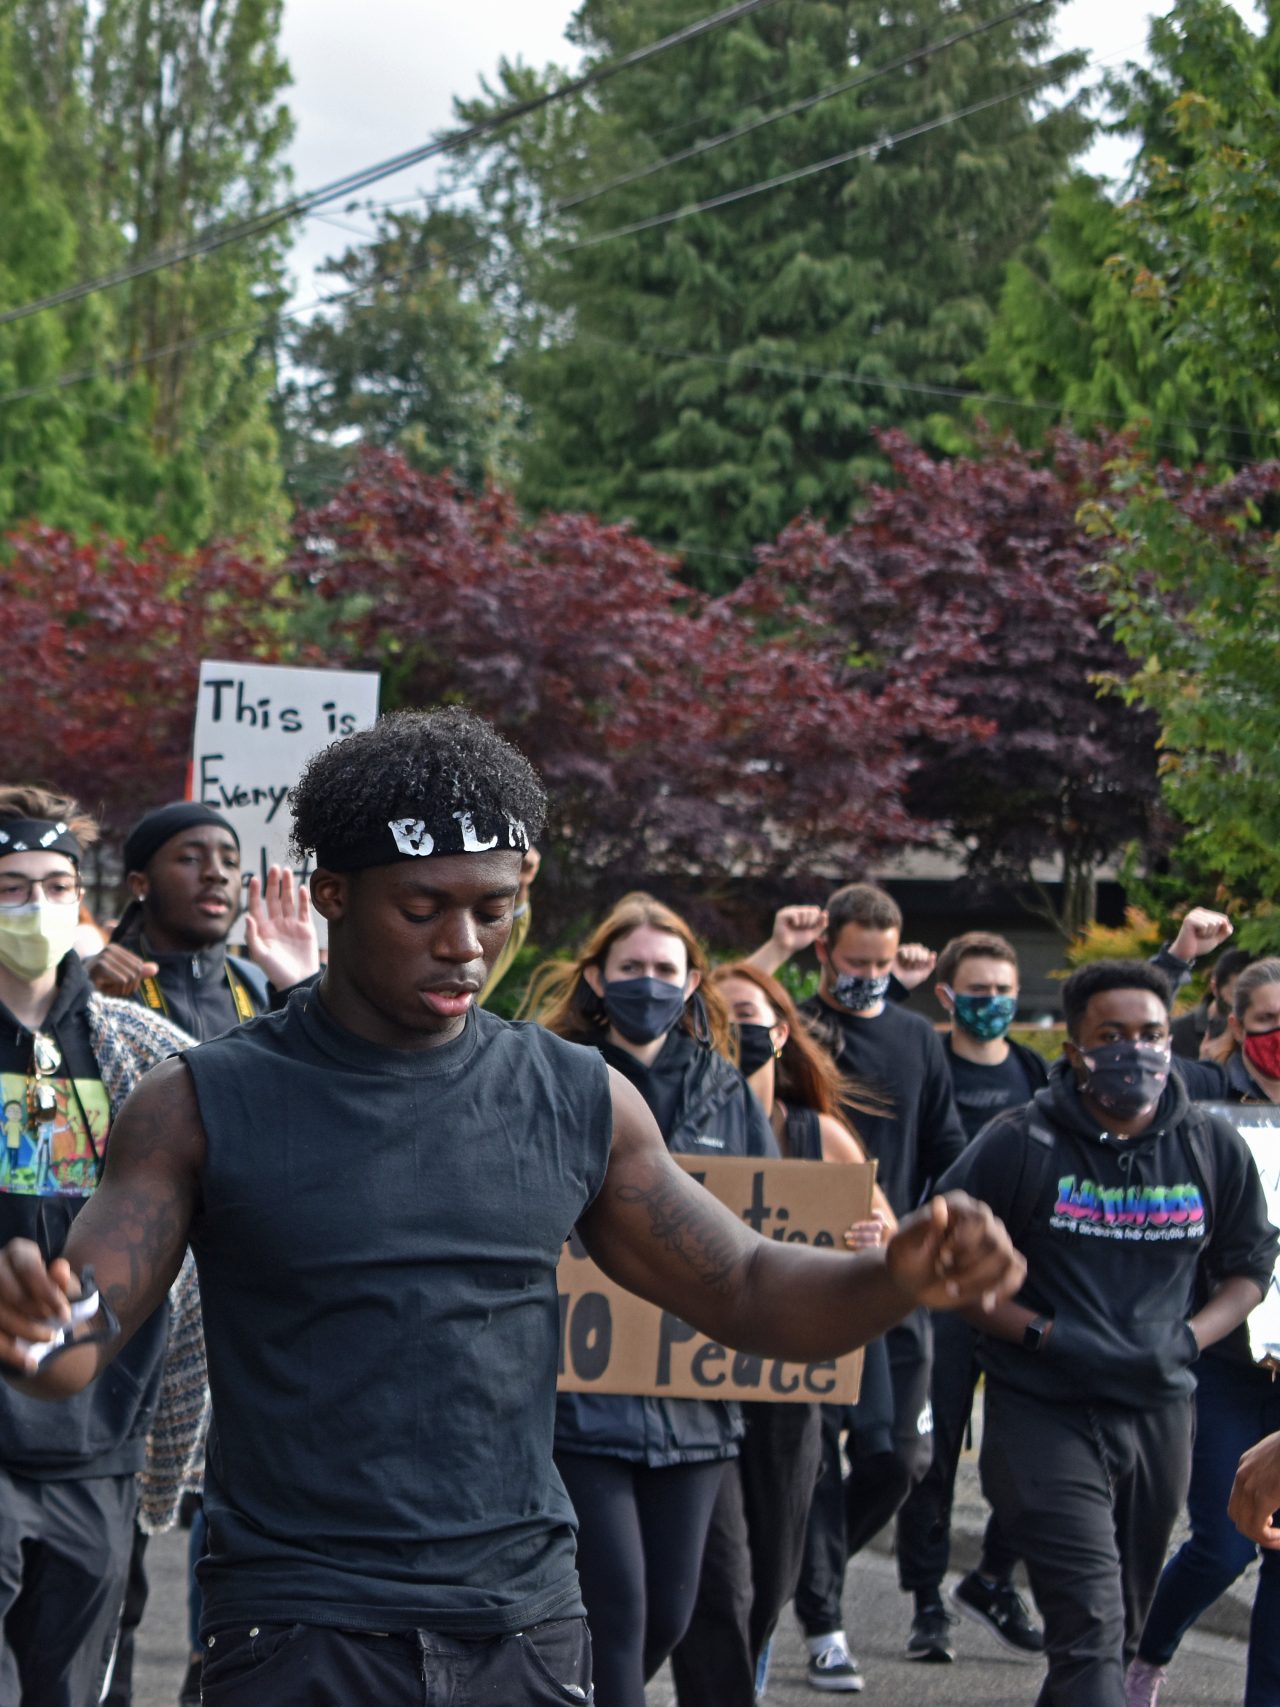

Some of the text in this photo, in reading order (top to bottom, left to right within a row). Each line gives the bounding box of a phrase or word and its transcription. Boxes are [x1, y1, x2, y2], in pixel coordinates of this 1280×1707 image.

[204, 680, 357, 736] This is
[656, 1309, 836, 1394] Peace
